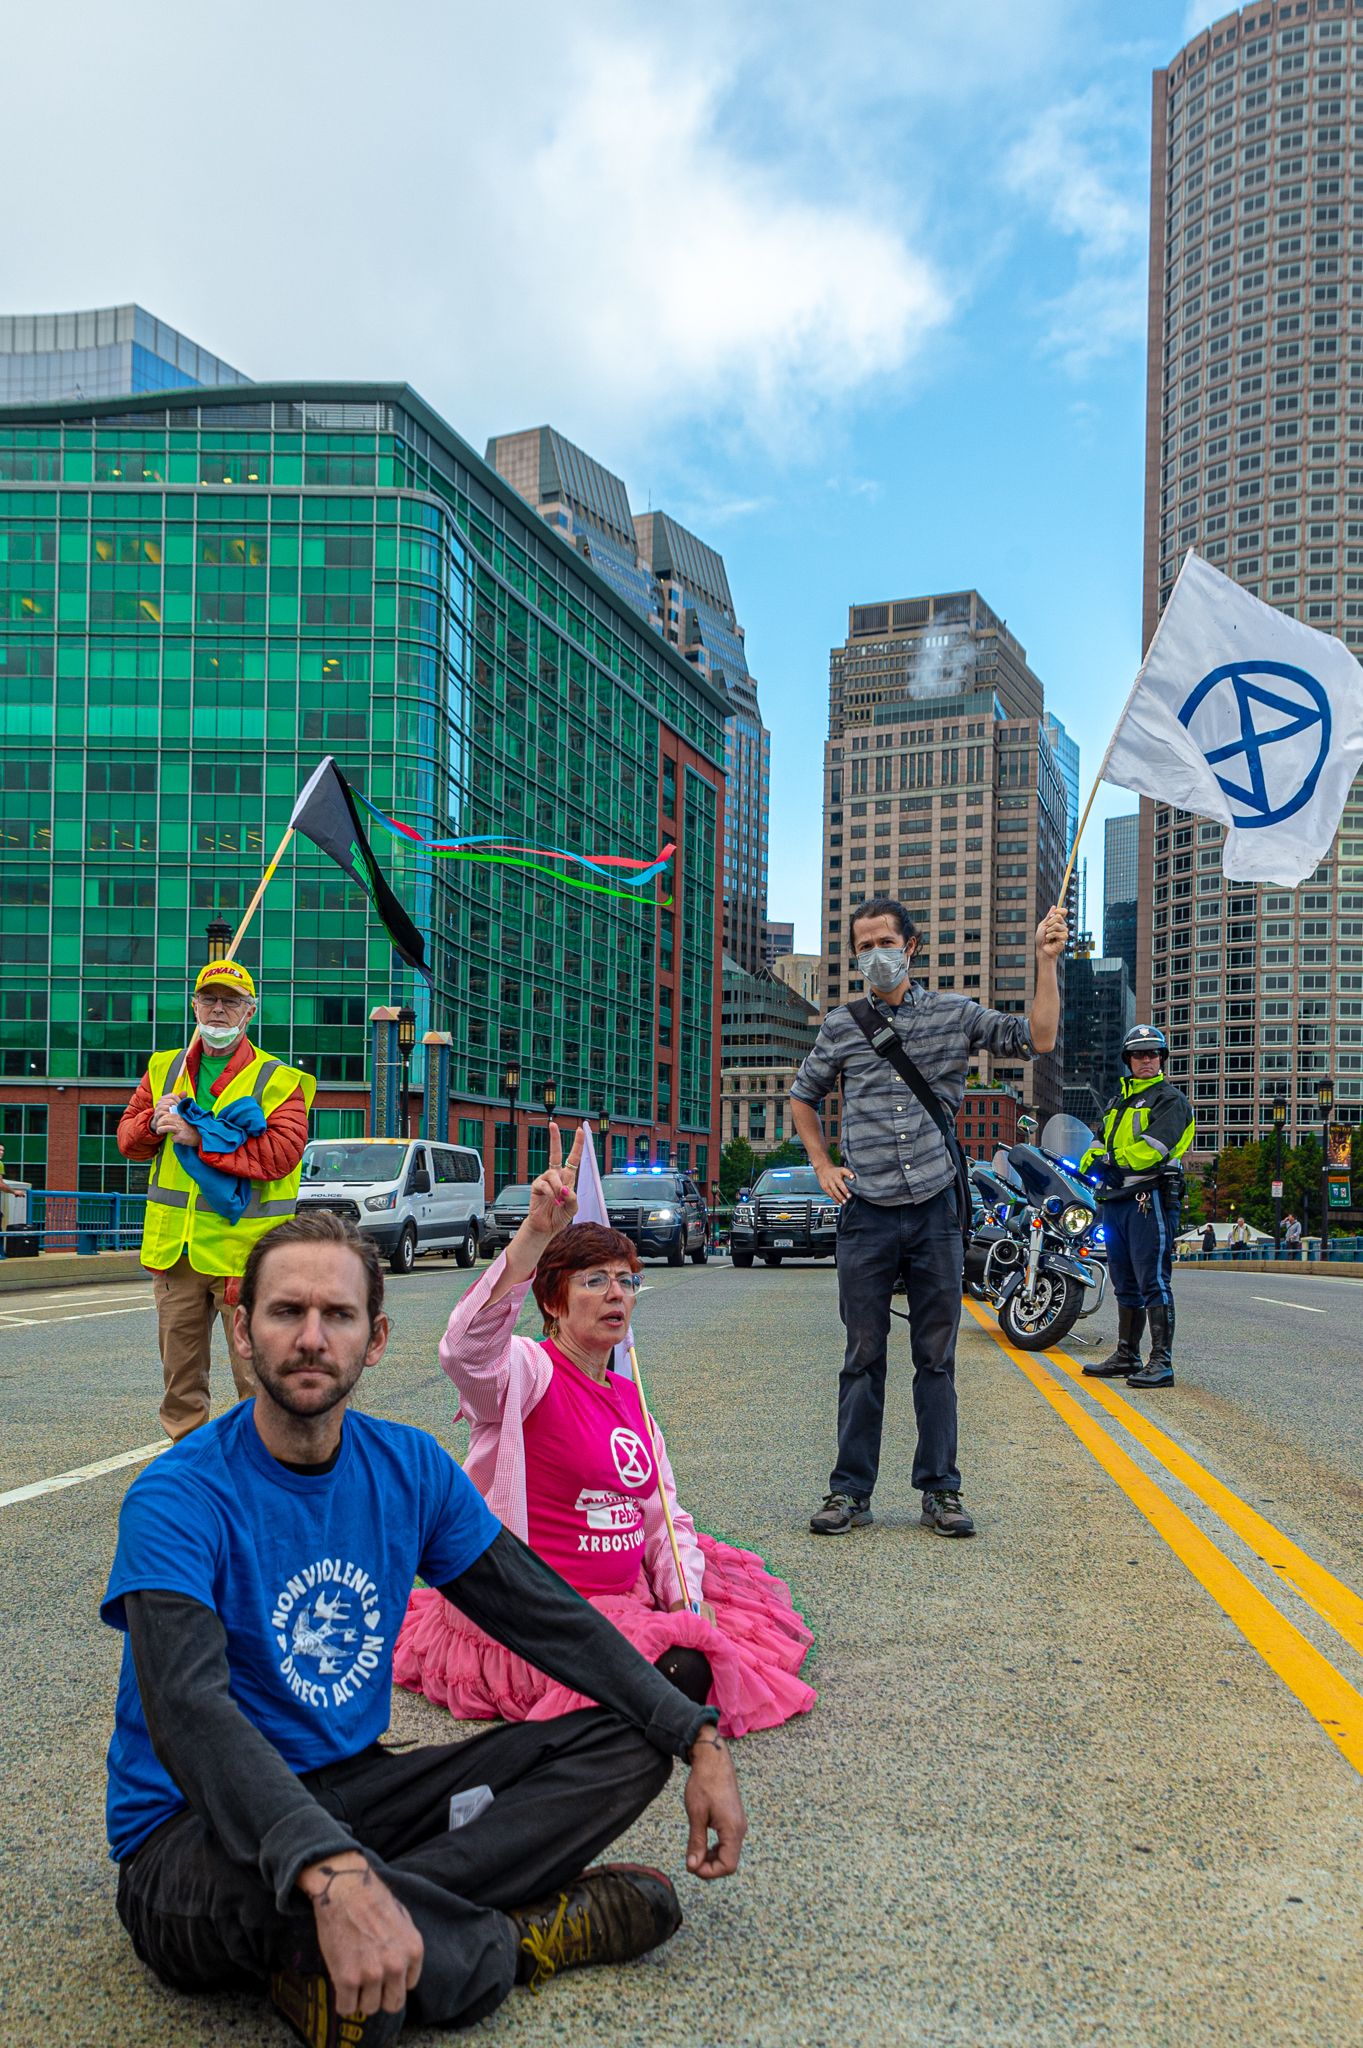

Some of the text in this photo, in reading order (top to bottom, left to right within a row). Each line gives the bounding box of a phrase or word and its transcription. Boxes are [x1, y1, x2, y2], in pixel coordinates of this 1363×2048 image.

[272, 1558, 379, 1629] NONVIOLENCE
[280, 1635, 384, 1708] DIRECT ACTION
